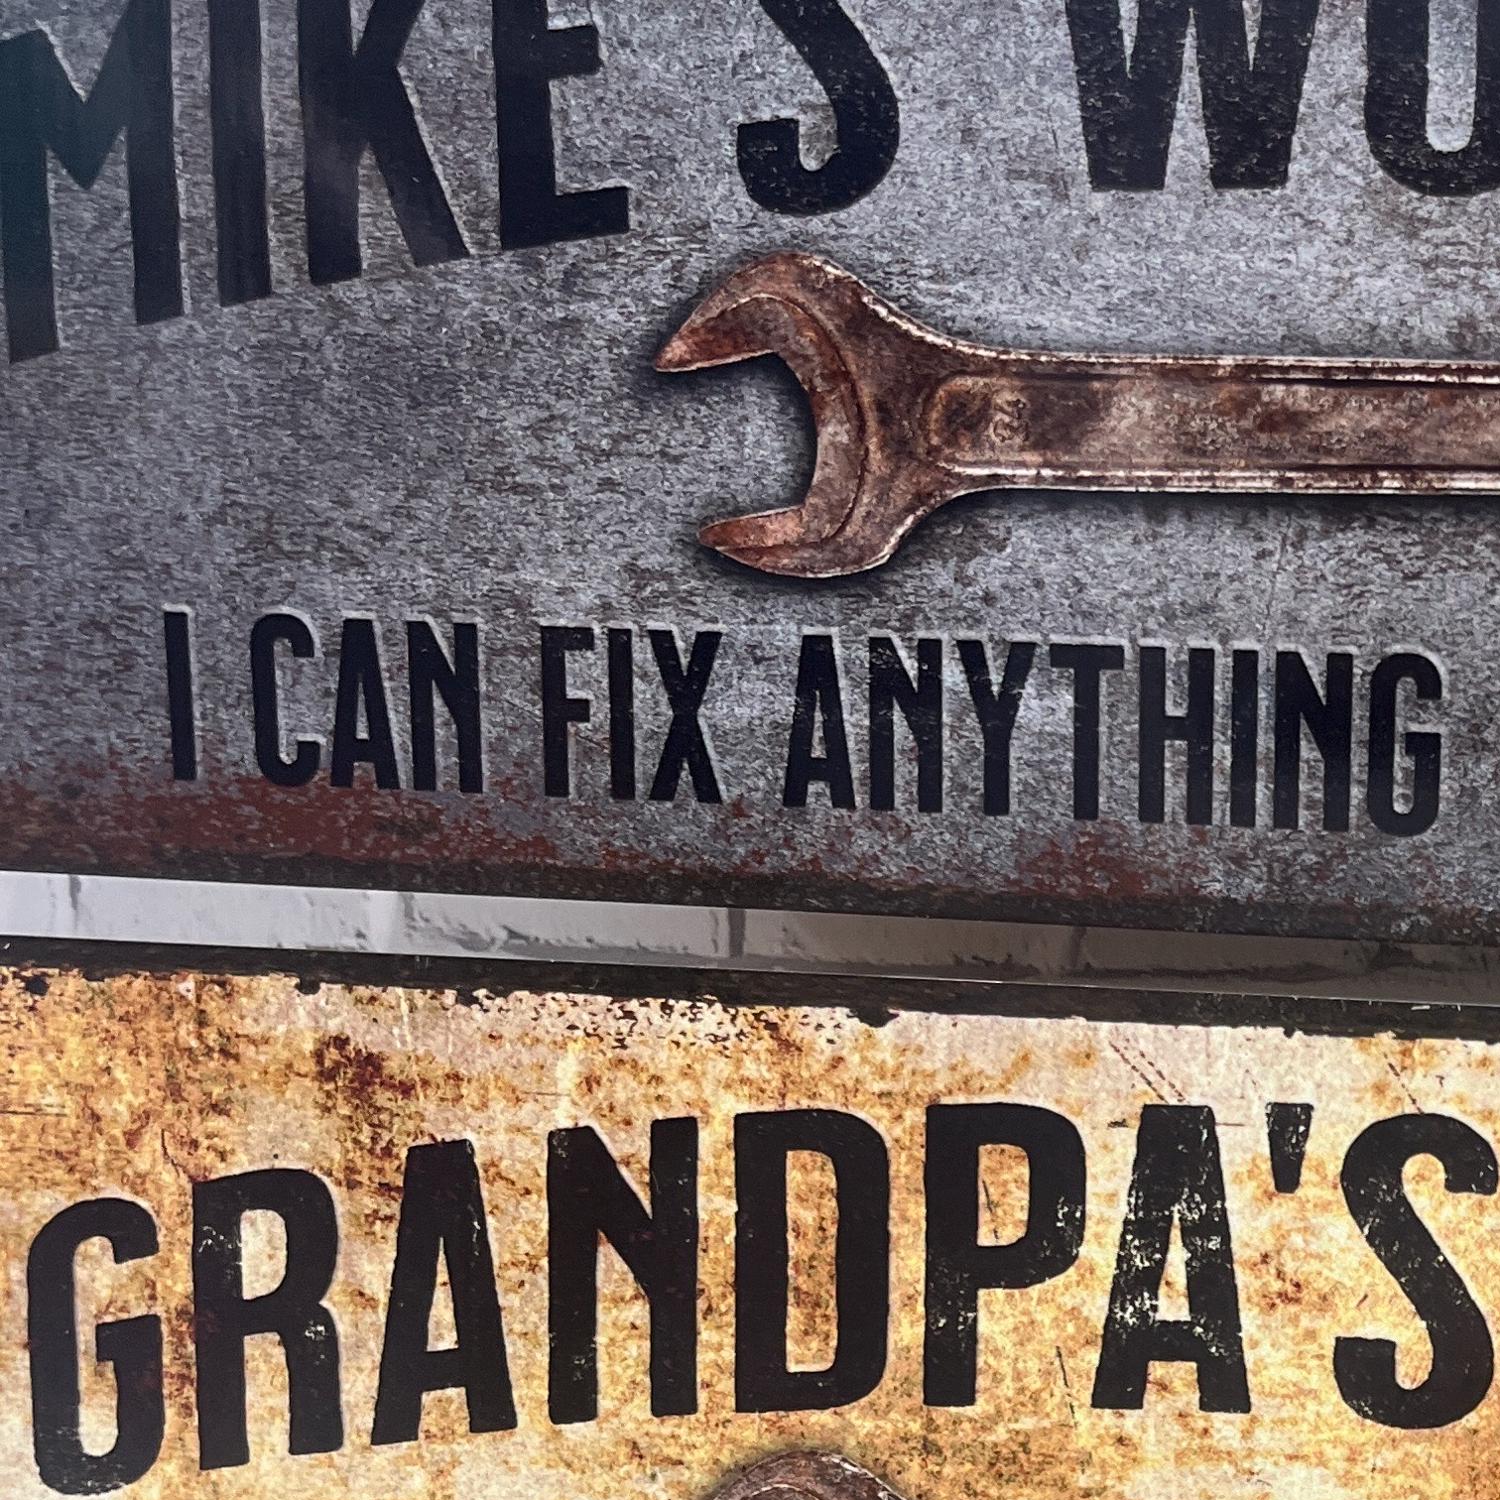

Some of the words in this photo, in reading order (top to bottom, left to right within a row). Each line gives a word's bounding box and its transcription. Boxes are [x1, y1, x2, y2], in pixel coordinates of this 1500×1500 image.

[0, 0, 900, 363] MIKES
[164, 611, 196, 780] I
[250, 613, 483, 794] CAN
[541, 625, 723, 802] FIX
[783, 634, 1441, 838] ANYTHING
[27, 1102, 1498, 1496] GRANDPA'S
